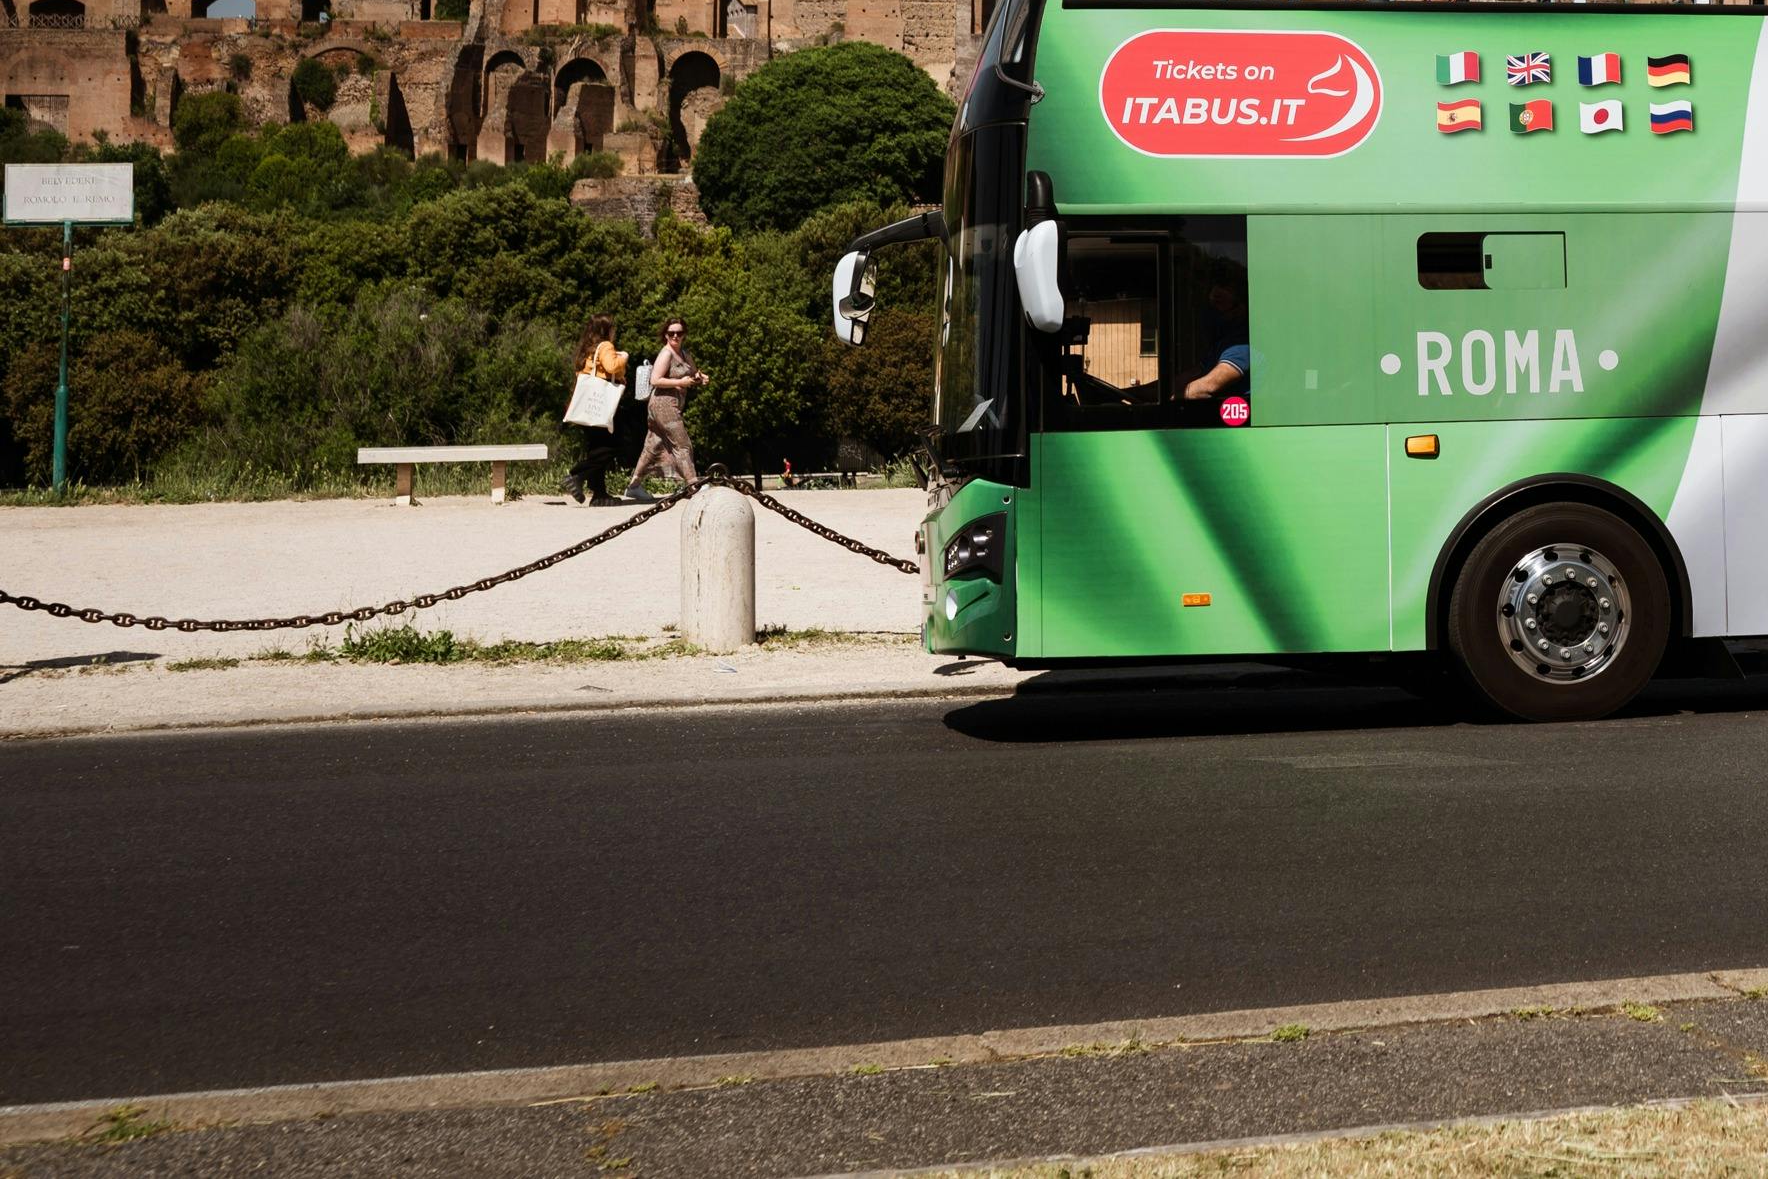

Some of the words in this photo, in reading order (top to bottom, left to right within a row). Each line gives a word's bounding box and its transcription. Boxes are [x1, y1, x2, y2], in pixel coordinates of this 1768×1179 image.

[1152, 59, 1238, 80] Tickets
[1244, 64, 1275, 80] on
[1122, 97, 1306, 126] ITABUS.IT
[23, 196, 67, 204] ROMOLO
[1416, 329, 1585, 396] ROMA
[1222, 403, 1248, 419] 205
